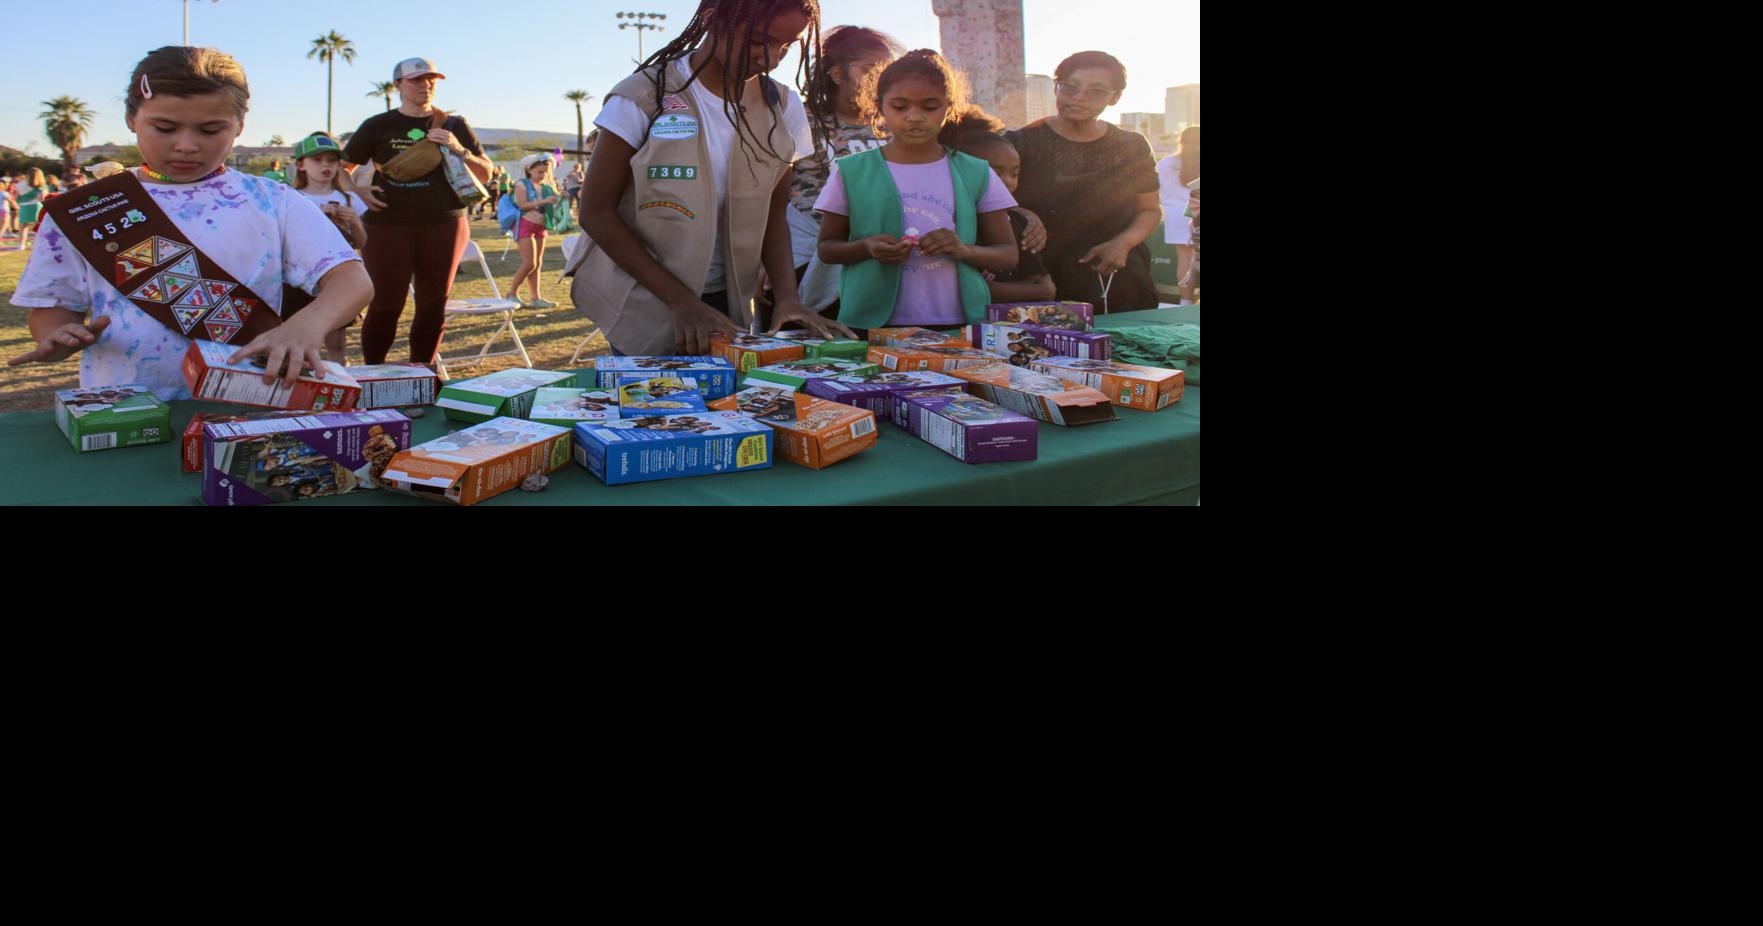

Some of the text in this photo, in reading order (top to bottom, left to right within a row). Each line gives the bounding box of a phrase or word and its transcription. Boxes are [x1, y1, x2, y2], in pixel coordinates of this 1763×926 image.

[650, 167, 694, 178] 7369
[68, 191, 125, 214] GIRL SCOUTS USA
